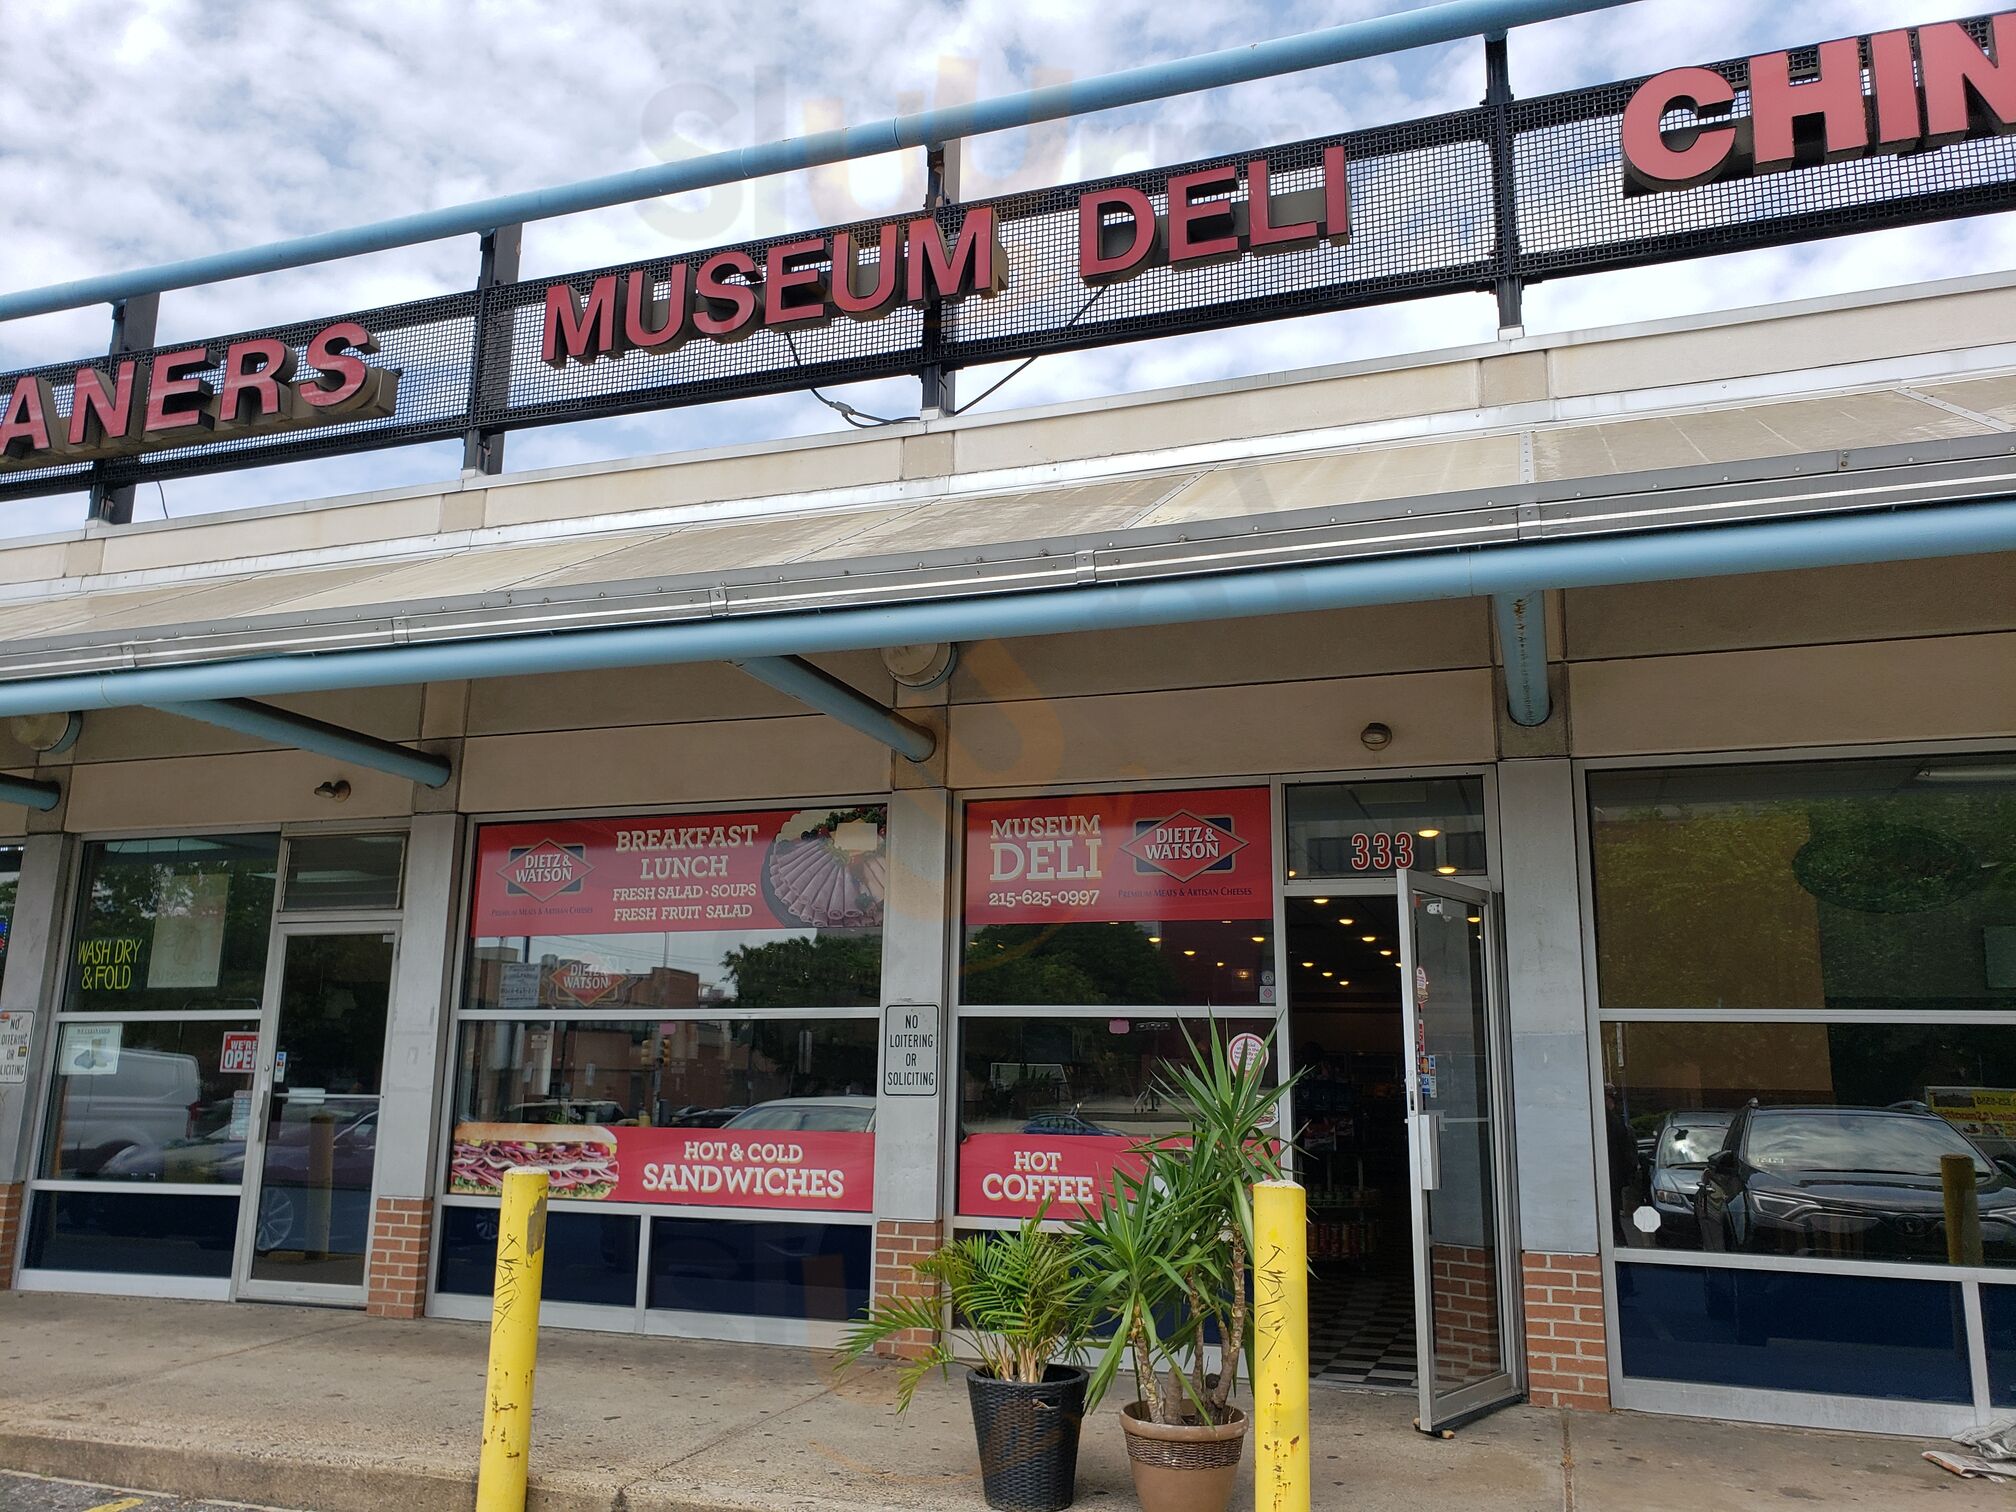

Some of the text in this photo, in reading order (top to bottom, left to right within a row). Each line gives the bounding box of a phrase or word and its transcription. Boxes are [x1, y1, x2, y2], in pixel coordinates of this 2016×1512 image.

[1622, 12, 2016, 184] CHIN
[541, 145, 1348, 366] MUSEUM DELI
[0, 322, 378, 456] ANERS
[990, 815, 1100, 839] MUSEUM
[1156, 827, 1219, 844] DIETZ &
[616, 825, 758, 852] BREAKFAST
[990, 839, 1102, 882] DELI
[1144, 842, 1220, 860] WATSON
[1351, 831, 1414, 870] 333
[525, 854, 572, 869] DIETZ &
[640, 855, 728, 879] LUNCH
[516, 867, 573, 882] WATSON
[612, 883, 757, 901] FRESH SALAD SOUPS
[988, 889, 1100, 908] 215-625-0997
[614, 904, 753, 921] FRESH FRUIT SALAD
[78, 938, 143, 965] WASH DRY
[81, 965, 131, 990] & FOLD
[563, 976, 609, 990] WATSON
[10, 1018, 20, 1030] NO
[905, 1014, 919, 1029] NO
[231, 1039, 258, 1050] WE'RE
[890, 1034, 933, 1048] LOITERING
[905, 1052, 917, 1067] OR
[887, 1072, 934, 1086] SOLICITING
[684, 1141, 804, 1164] HOT & COLD
[1013, 1151, 1062, 1173] HOT
[642, 1163, 845, 1198] SANDWICHES
[982, 1173, 1095, 1204] COFFEE
